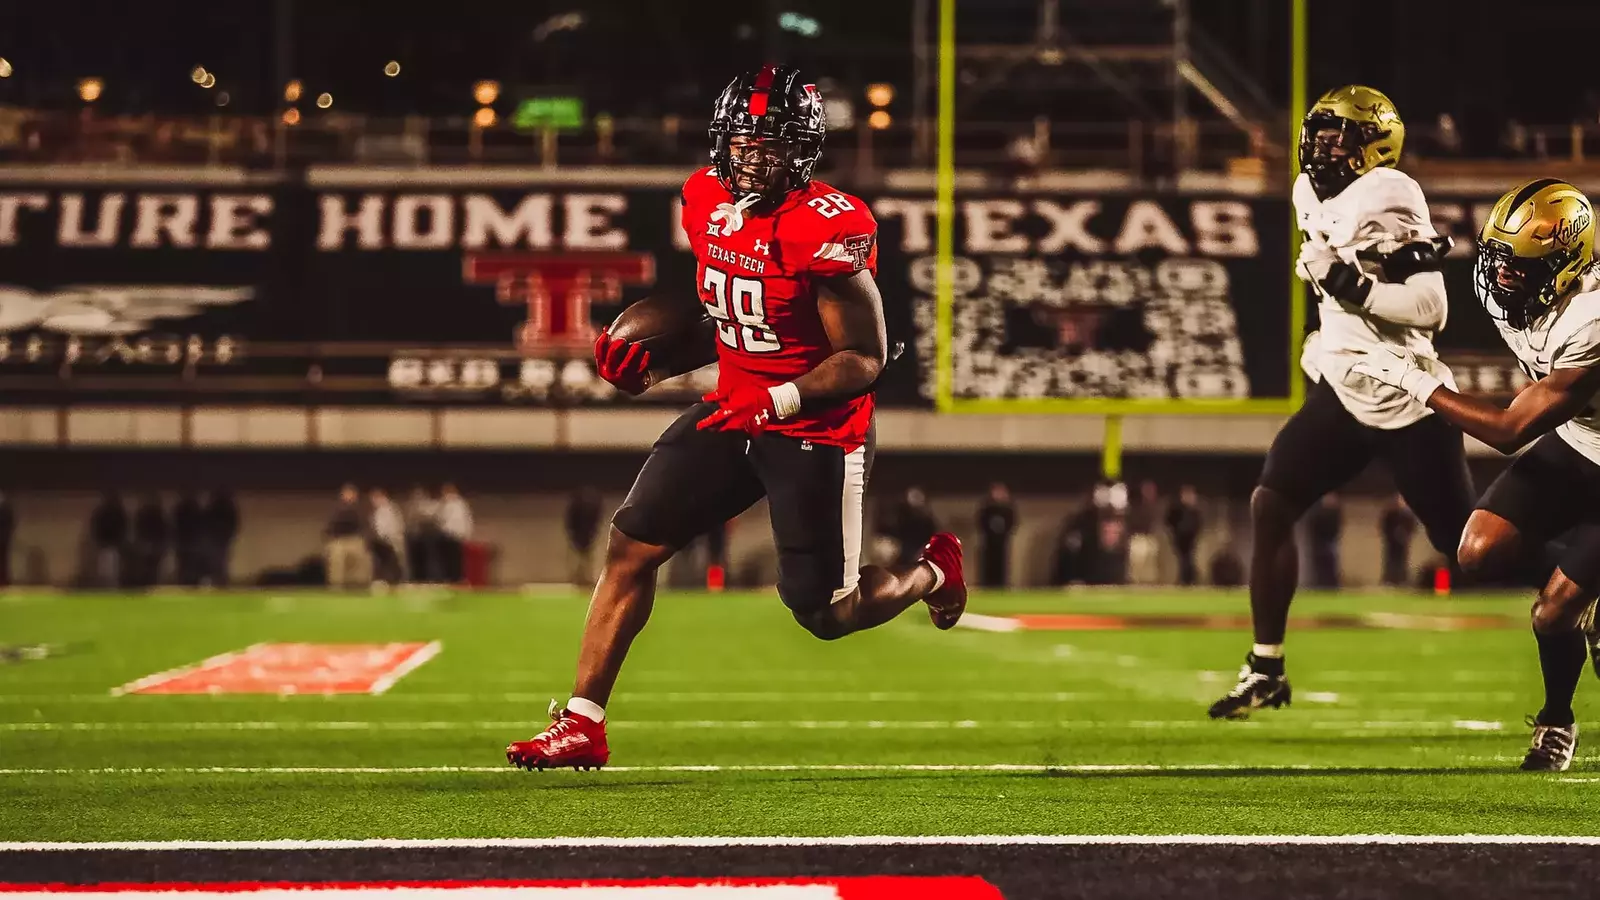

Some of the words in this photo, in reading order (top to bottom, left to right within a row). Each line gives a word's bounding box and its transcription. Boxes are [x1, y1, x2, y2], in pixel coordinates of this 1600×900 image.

[317, 194, 628, 249] HOME
[873, 199, 1258, 256] TEXAS
[807, 193, 855, 218] 28
[707, 243, 736, 264] TEXAS
[739, 253, 765, 274] TECH
[702, 265, 781, 353] 28
